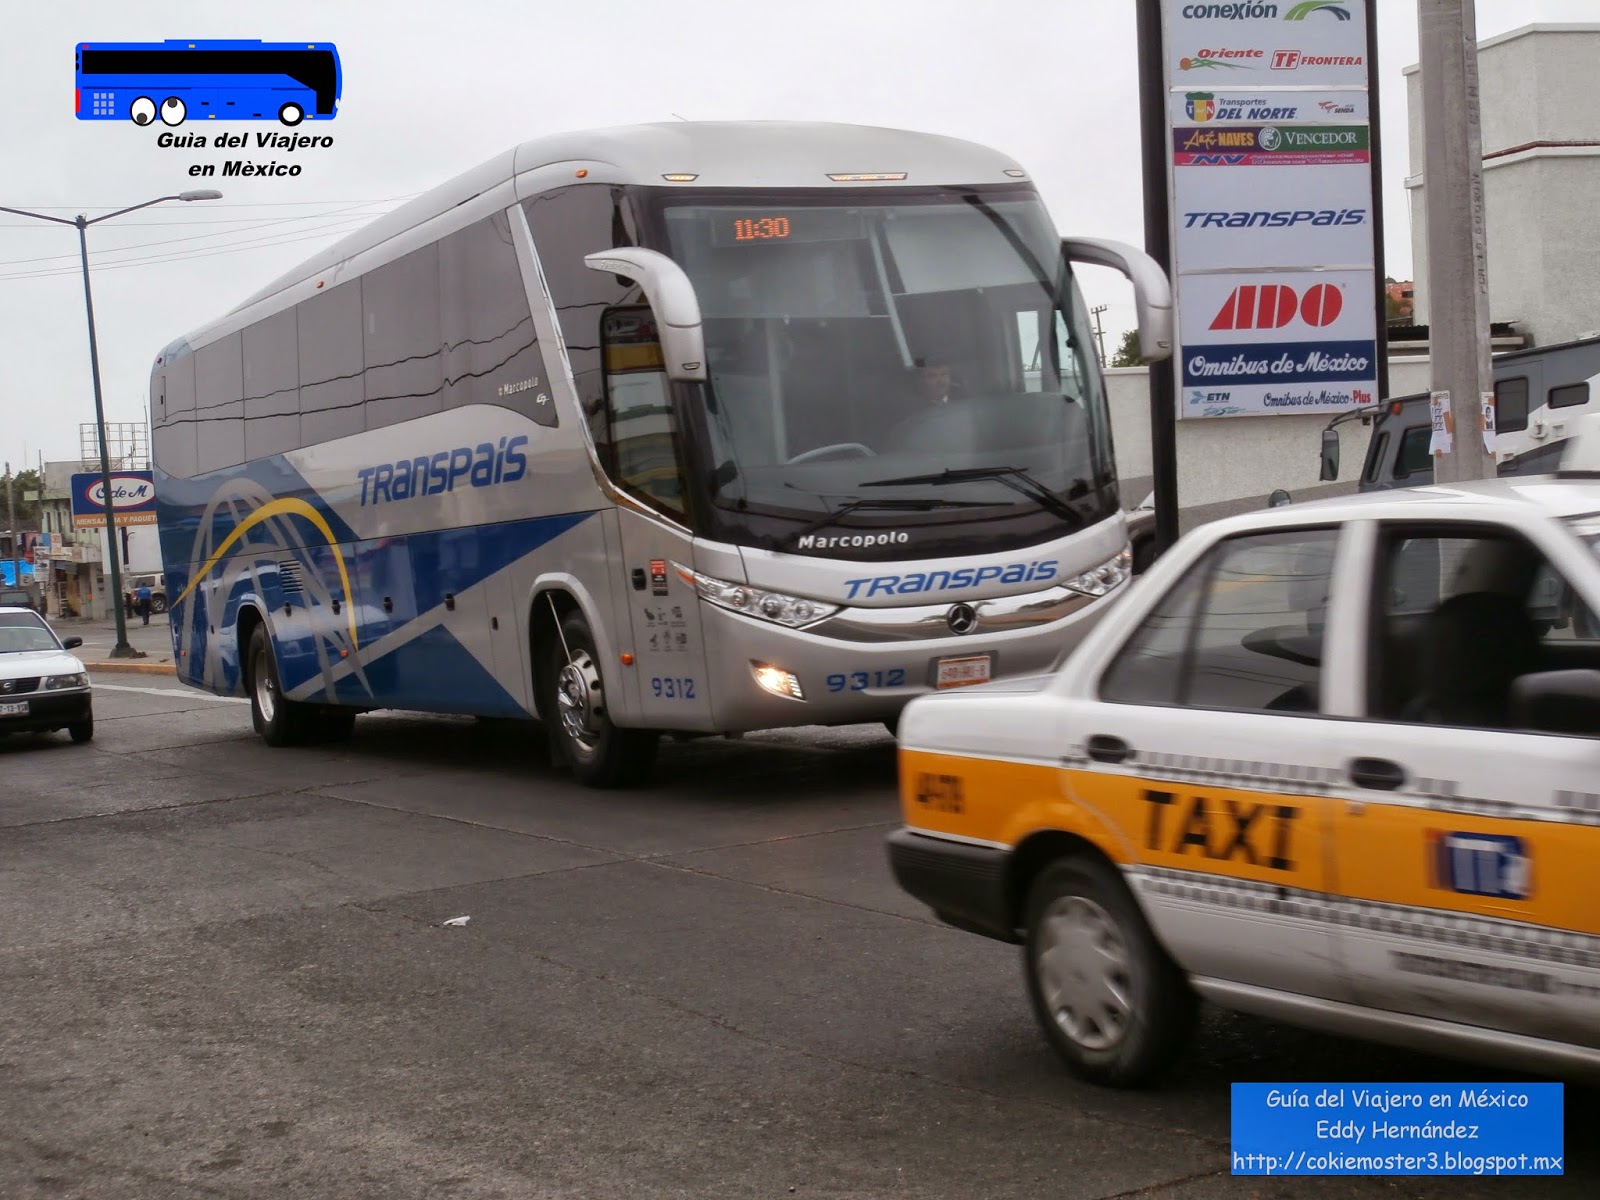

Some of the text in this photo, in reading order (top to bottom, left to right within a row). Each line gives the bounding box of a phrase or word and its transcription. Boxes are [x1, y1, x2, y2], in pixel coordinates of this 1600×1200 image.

[1182, 0, 1278, 20] conexión
[1197, 49, 1264, 59] Oriente
[1275, 52, 1362, 67] TF FRONTERA
[1219, 98, 1267, 107] Transportes
[1215, 107, 1297, 120] DEL NORTE
[1218, 132, 1255, 146] NAVES
[1285, 131, 1358, 145] VENCEDOR
[734, 217, 790, 240] 11:30
[1208, 283, 1343, 330] ADO
[1188, 351, 1369, 377] Omnibus de México
[1207, 392, 1231, 401] ETN
[1302, 390, 1313, 405] de
[1352, 389, 1371, 404] Plus
[111, 485, 127, 499] de
[128, 484, 148, 498] M
[76, 517, 121, 526] MENSAJIA
[798, 531, 909, 549] Marcopolo
[652, 677, 695, 699] 9312
[826, 668, 905, 693] 9312
[1141, 789, 1302, 871] TAXI
